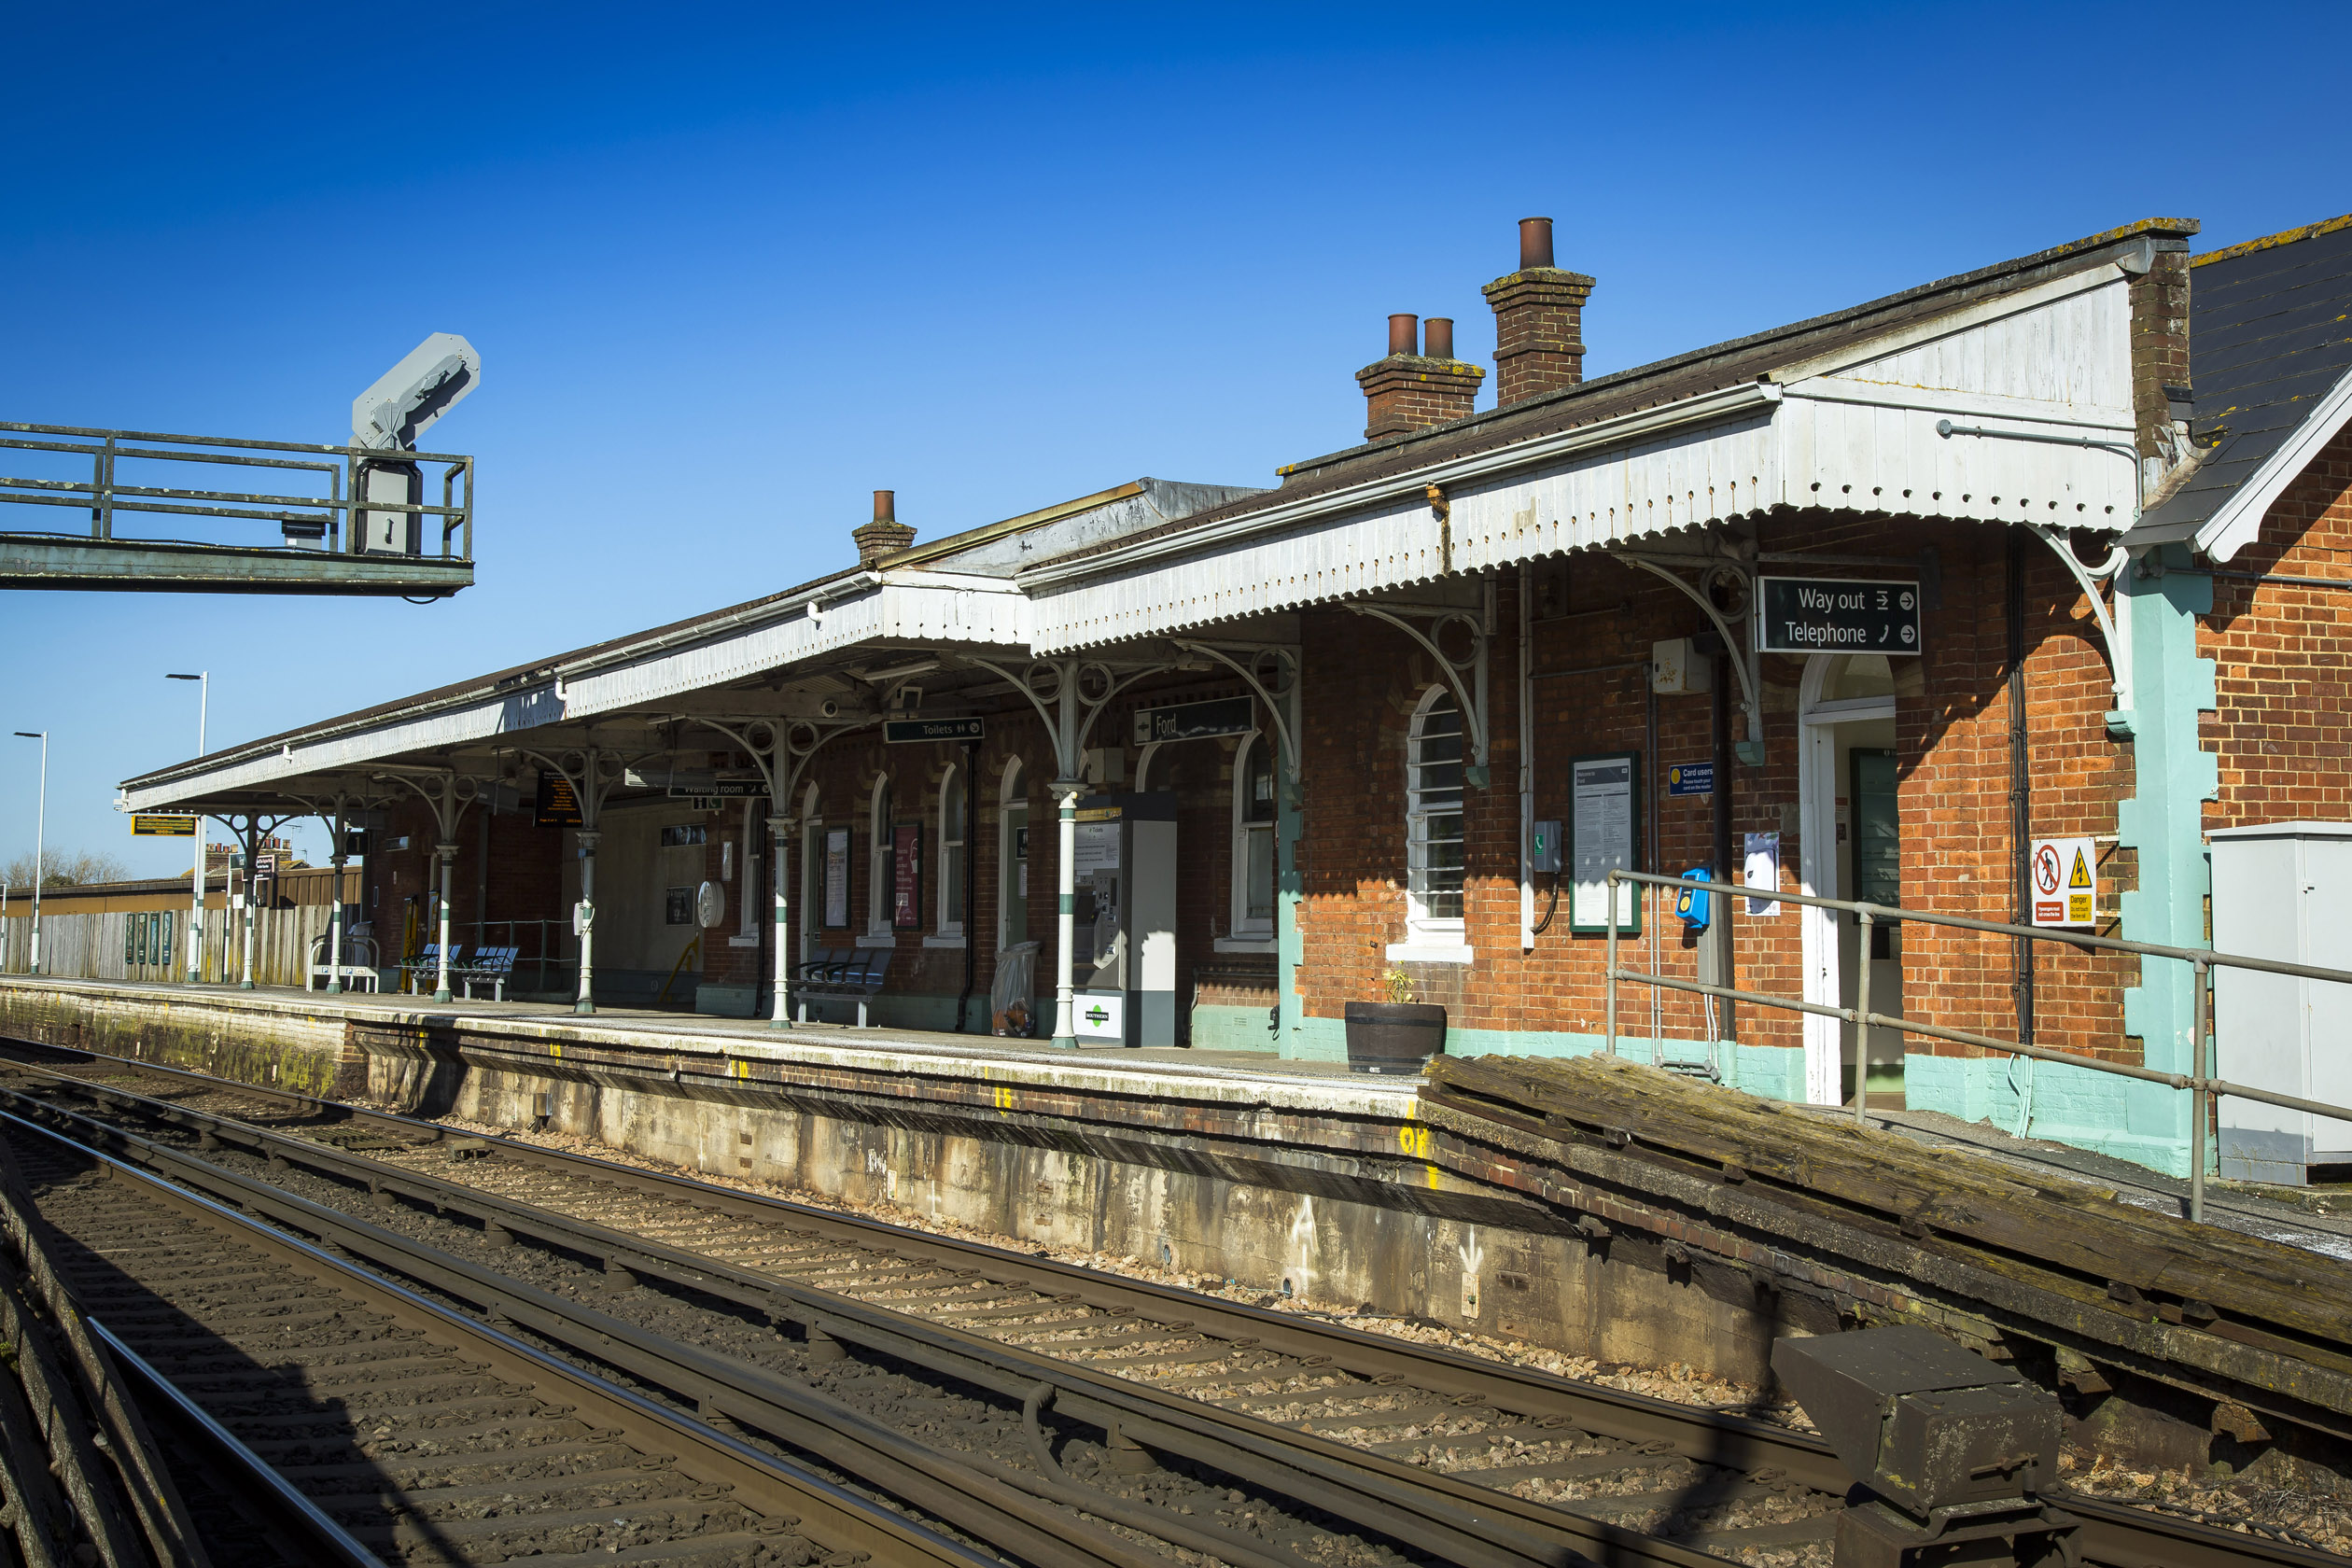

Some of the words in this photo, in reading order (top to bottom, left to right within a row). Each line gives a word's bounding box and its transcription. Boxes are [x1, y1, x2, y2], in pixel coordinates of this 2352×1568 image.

[1798, 587, 1835, 614] Way
[1838, 591, 1866, 609] out
[1785, 621, 1867, 648] Telephone
[1156, 712, 1176, 735] Ford
[922, 725, 953, 735] Toilets
[1683, 768, 1697, 777] Card
[685, 785, 719, 795] Waiting
[721, 785, 744, 793] room
[355, 836, 360, 851] 1
[2070, 896, 2087, 904] Danger
